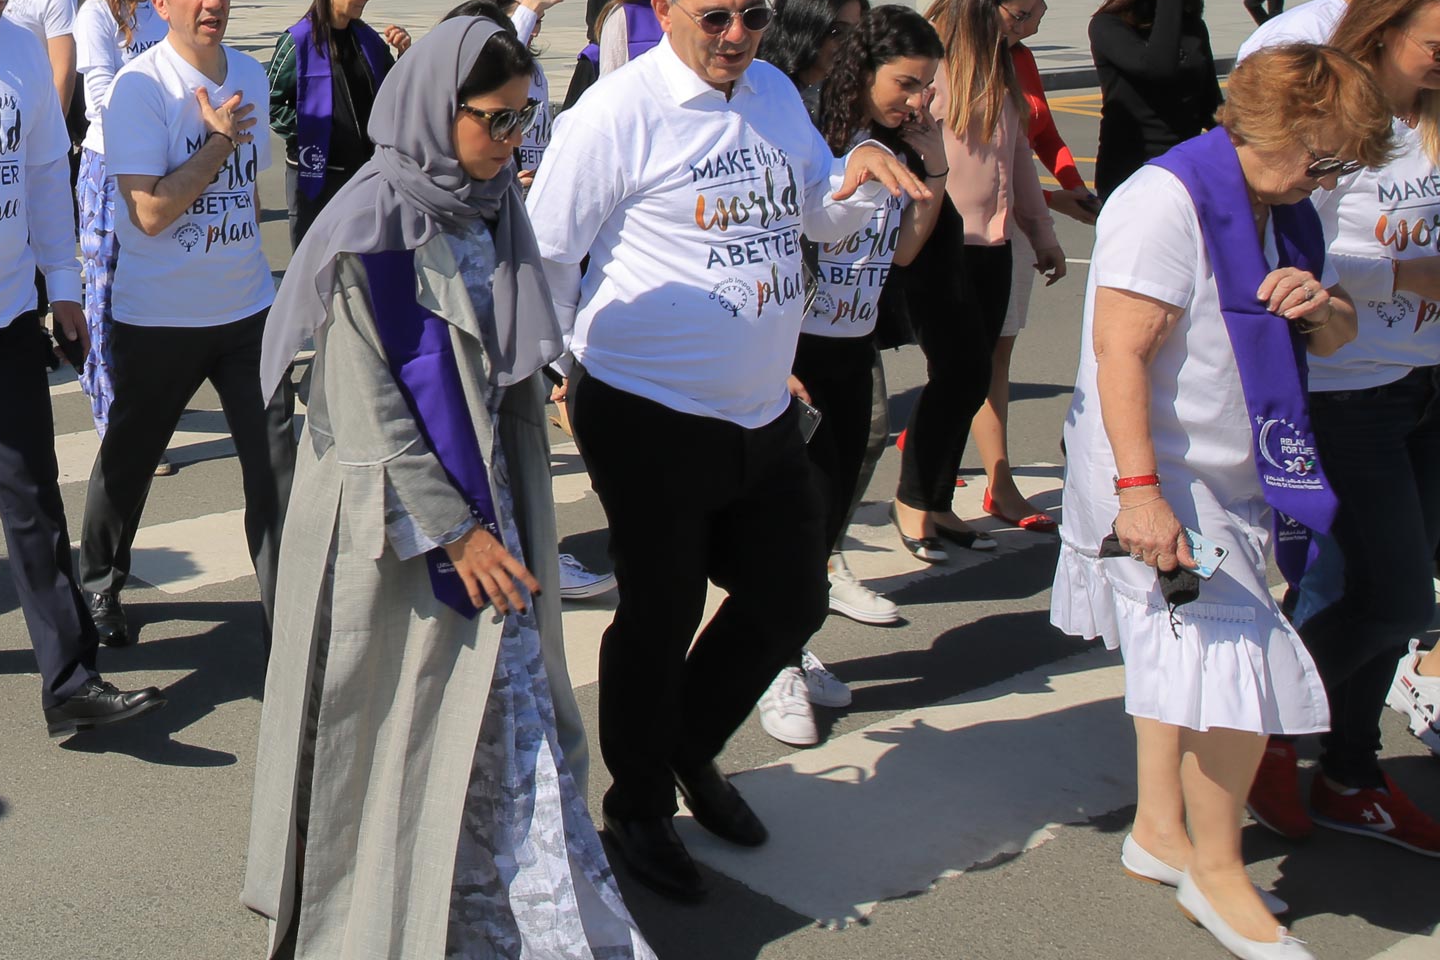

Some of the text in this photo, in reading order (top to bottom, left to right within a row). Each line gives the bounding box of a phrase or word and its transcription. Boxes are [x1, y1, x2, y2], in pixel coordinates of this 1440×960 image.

[690, 142, 789, 182] MAKE this
[695, 164, 801, 231] world
[707, 229, 801, 270] A BETTER
[1280, 438, 1306, 446] RELAY
[1281, 445, 1298, 454] FOR
